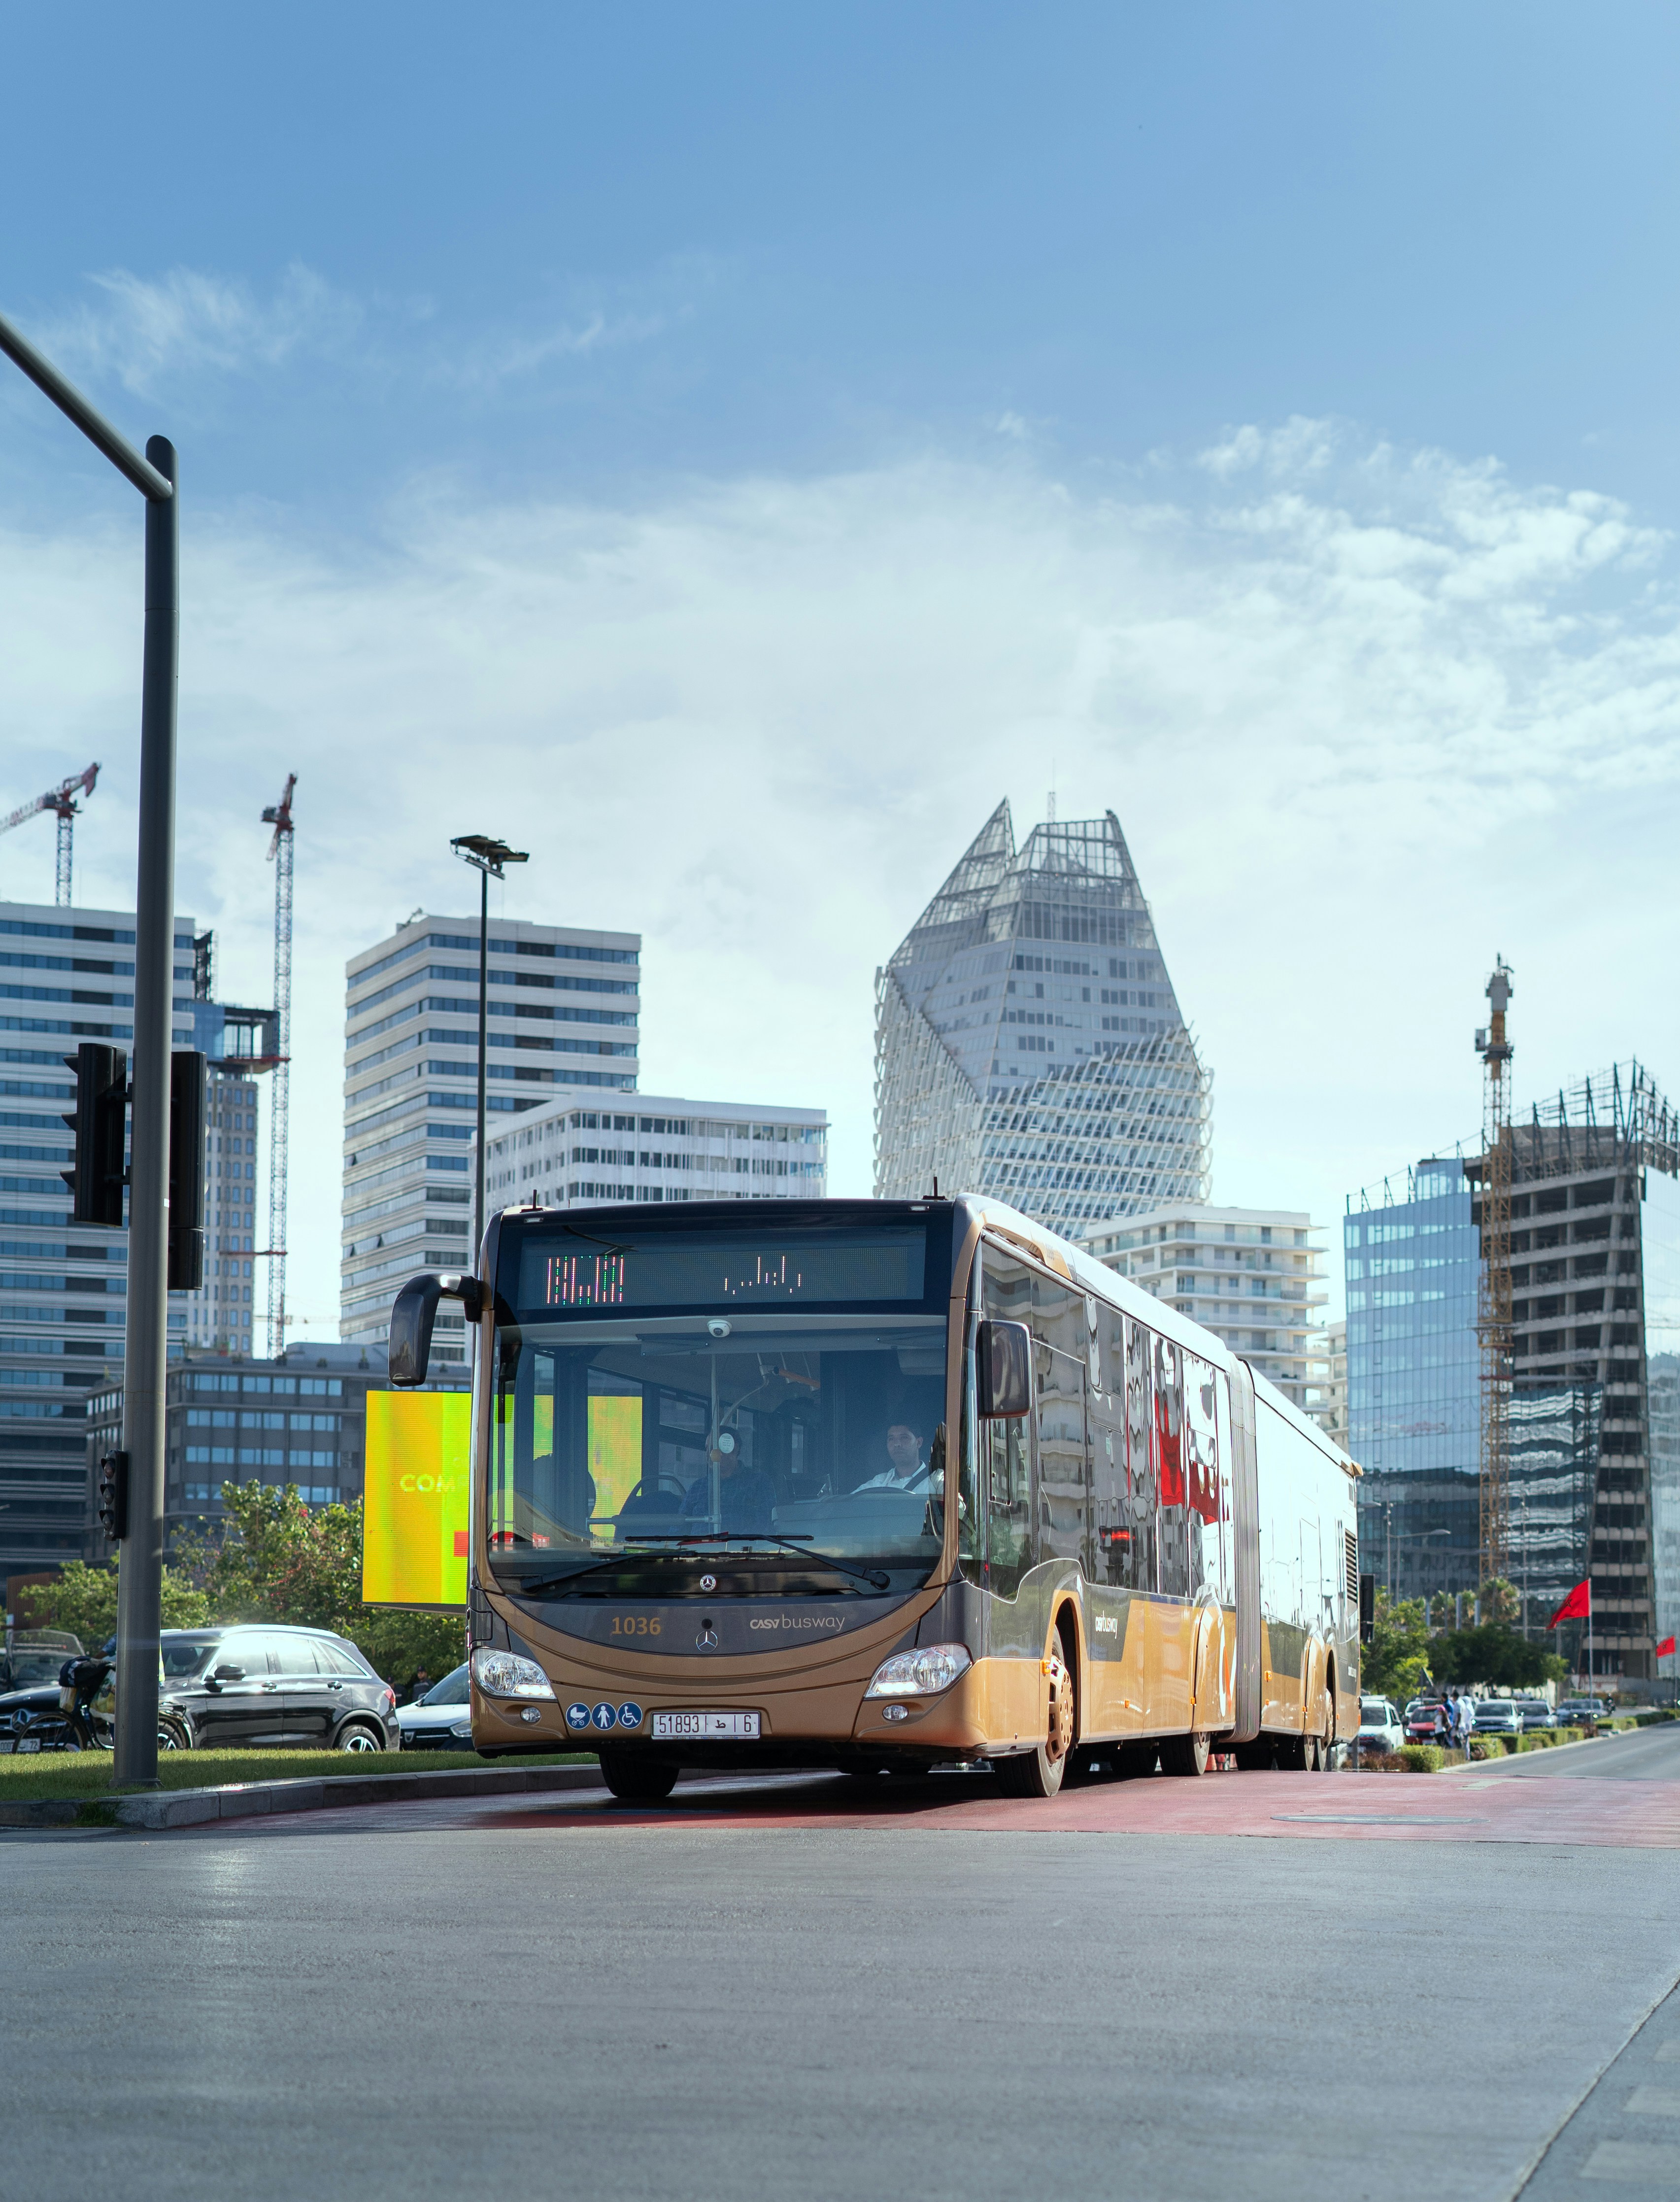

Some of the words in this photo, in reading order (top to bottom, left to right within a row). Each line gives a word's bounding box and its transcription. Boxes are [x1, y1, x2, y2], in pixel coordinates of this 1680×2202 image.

[611, 1617, 661, 1635] 1036
[659, 1715, 700, 1733] 51893
[715, 1719, 726, 1728] ط
[744, 1715, 751, 1732] 6
[30, 1740, 38, 1750] 72
